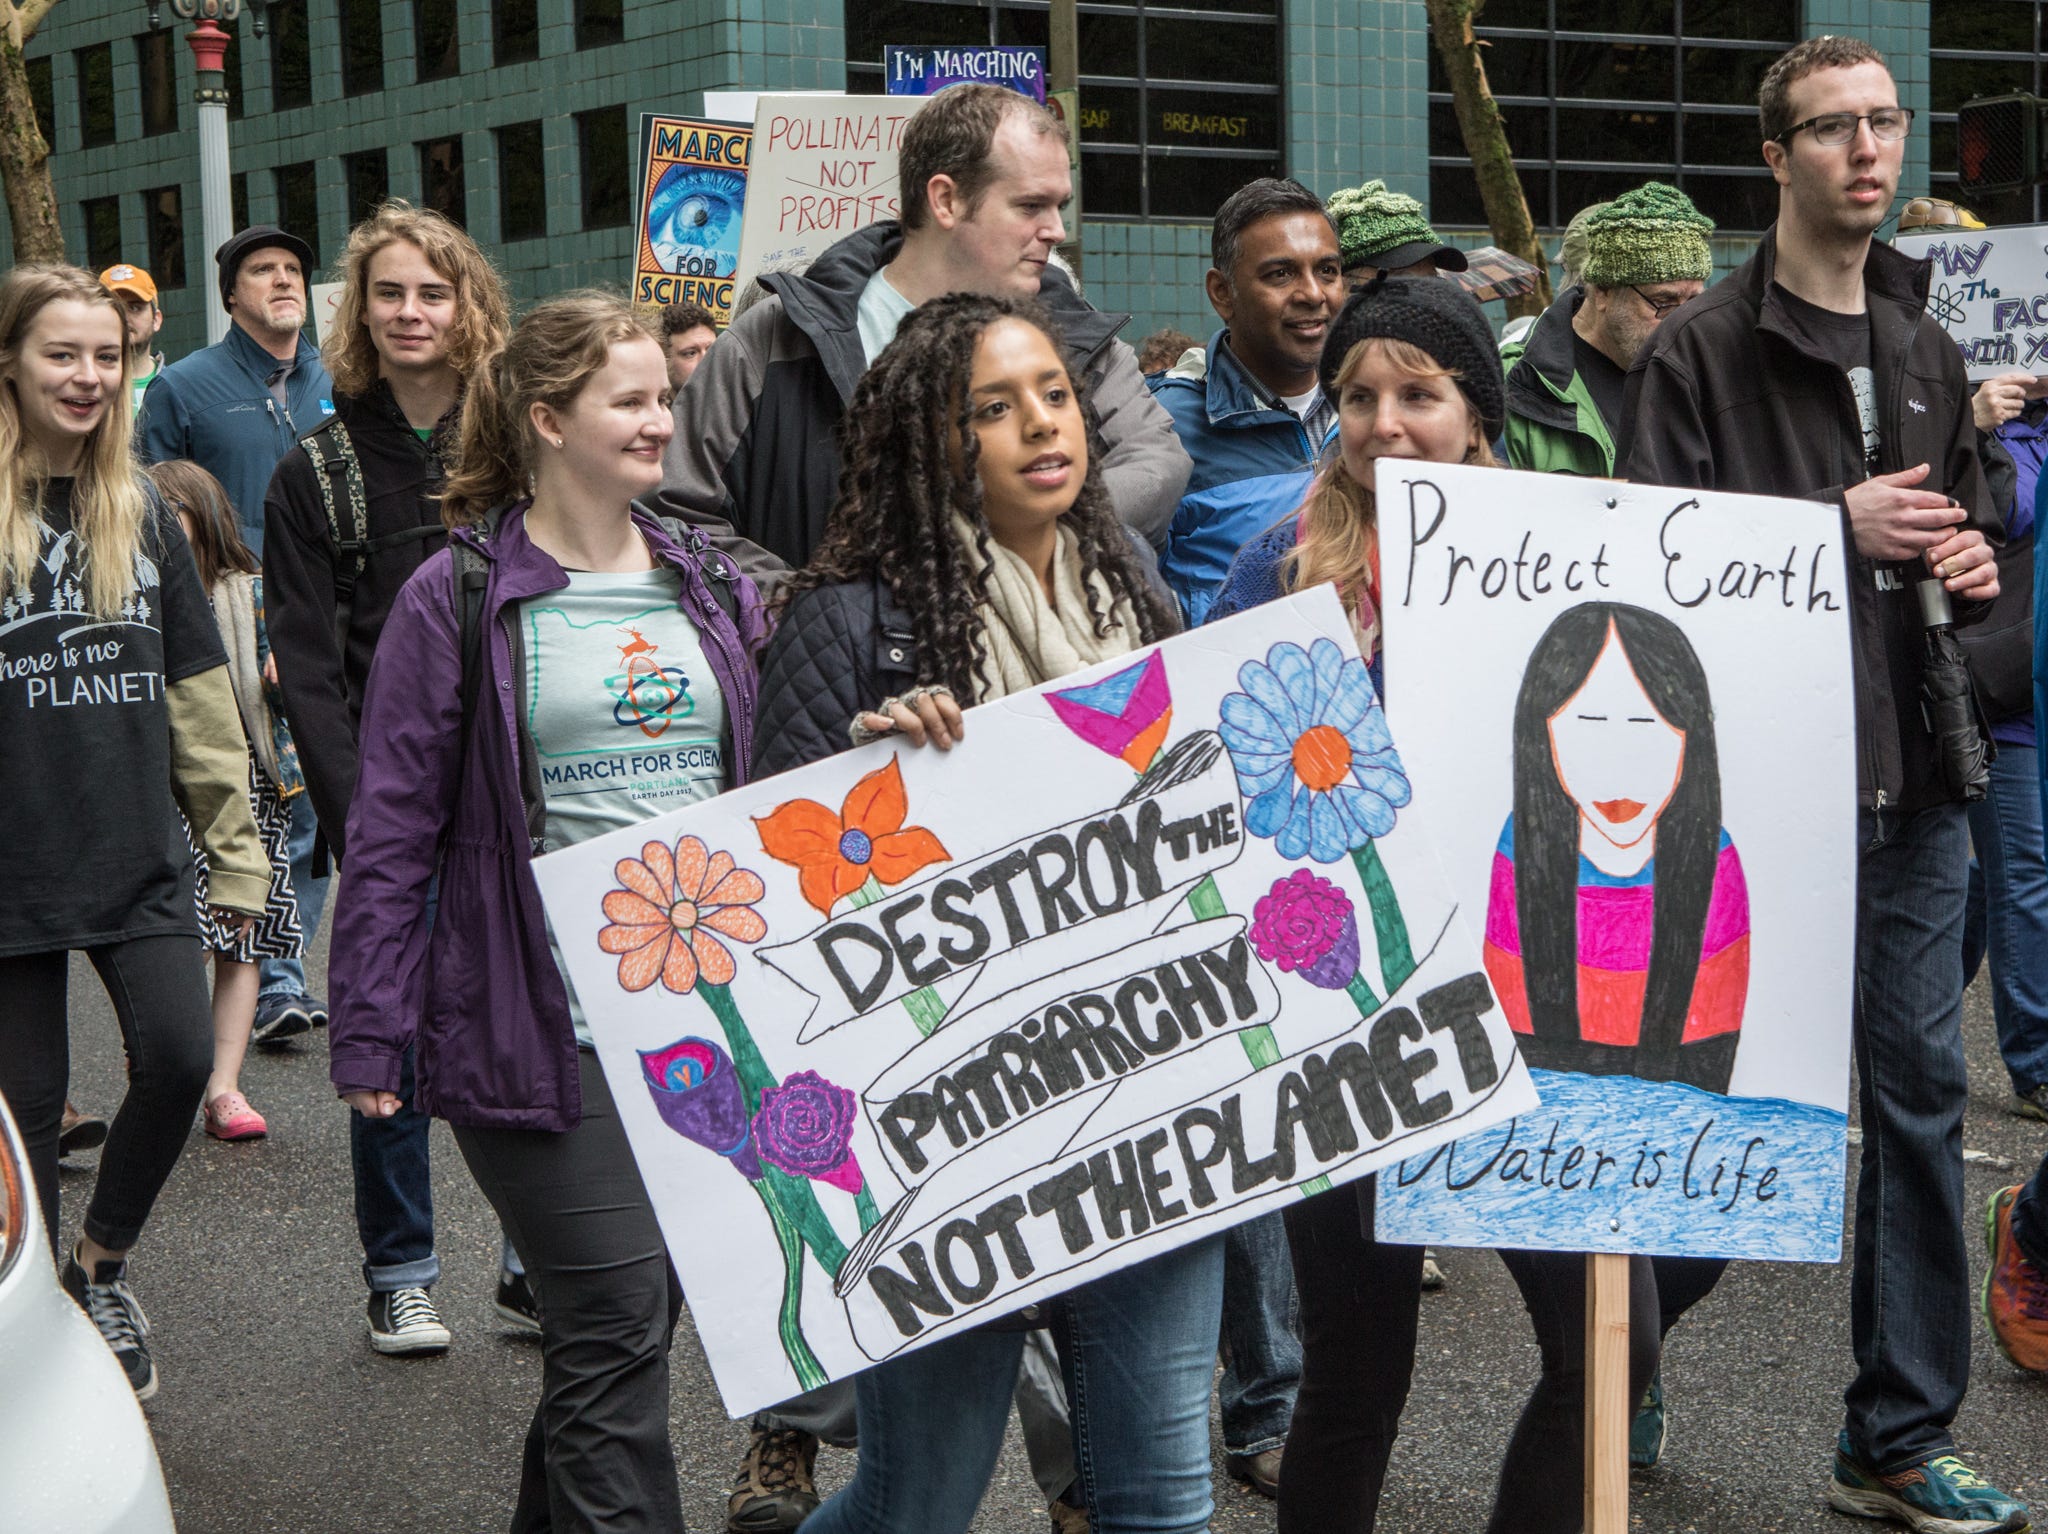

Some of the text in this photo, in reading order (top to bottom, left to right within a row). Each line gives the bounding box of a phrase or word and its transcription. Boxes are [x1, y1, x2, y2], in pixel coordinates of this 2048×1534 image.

[894, 50, 1038, 81] I'M MARCHING
[1162, 111, 1249, 137] BREAKFAST
[655, 126, 752, 166] MARC
[819, 160, 877, 188] NOT
[779, 195, 901, 232] PROFITS
[675, 255, 718, 277] FOR
[1925, 241, 1993, 279] MAY
[640, 277, 735, 310] SCIENC
[1961, 278, 2001, 301] The
[1401, 480, 1841, 613] Protect Earth
[0, 640, 124, 681] here is no
[27, 672, 158, 708] PLANET
[542, 749, 720, 785] MARCH FOR SCIEN
[629, 777, 690, 791] PORTLAND
[632, 787, 692, 800] EARTH DAY 2017
[813, 799, 1240, 1014] DESTROY THE
[1630, 1141, 1670, 1189] is
[1682, 1118, 1778, 1213] life
[867, 1194, 1036, 1337] NOT
[1027, 1127, 1188, 1256] THE
